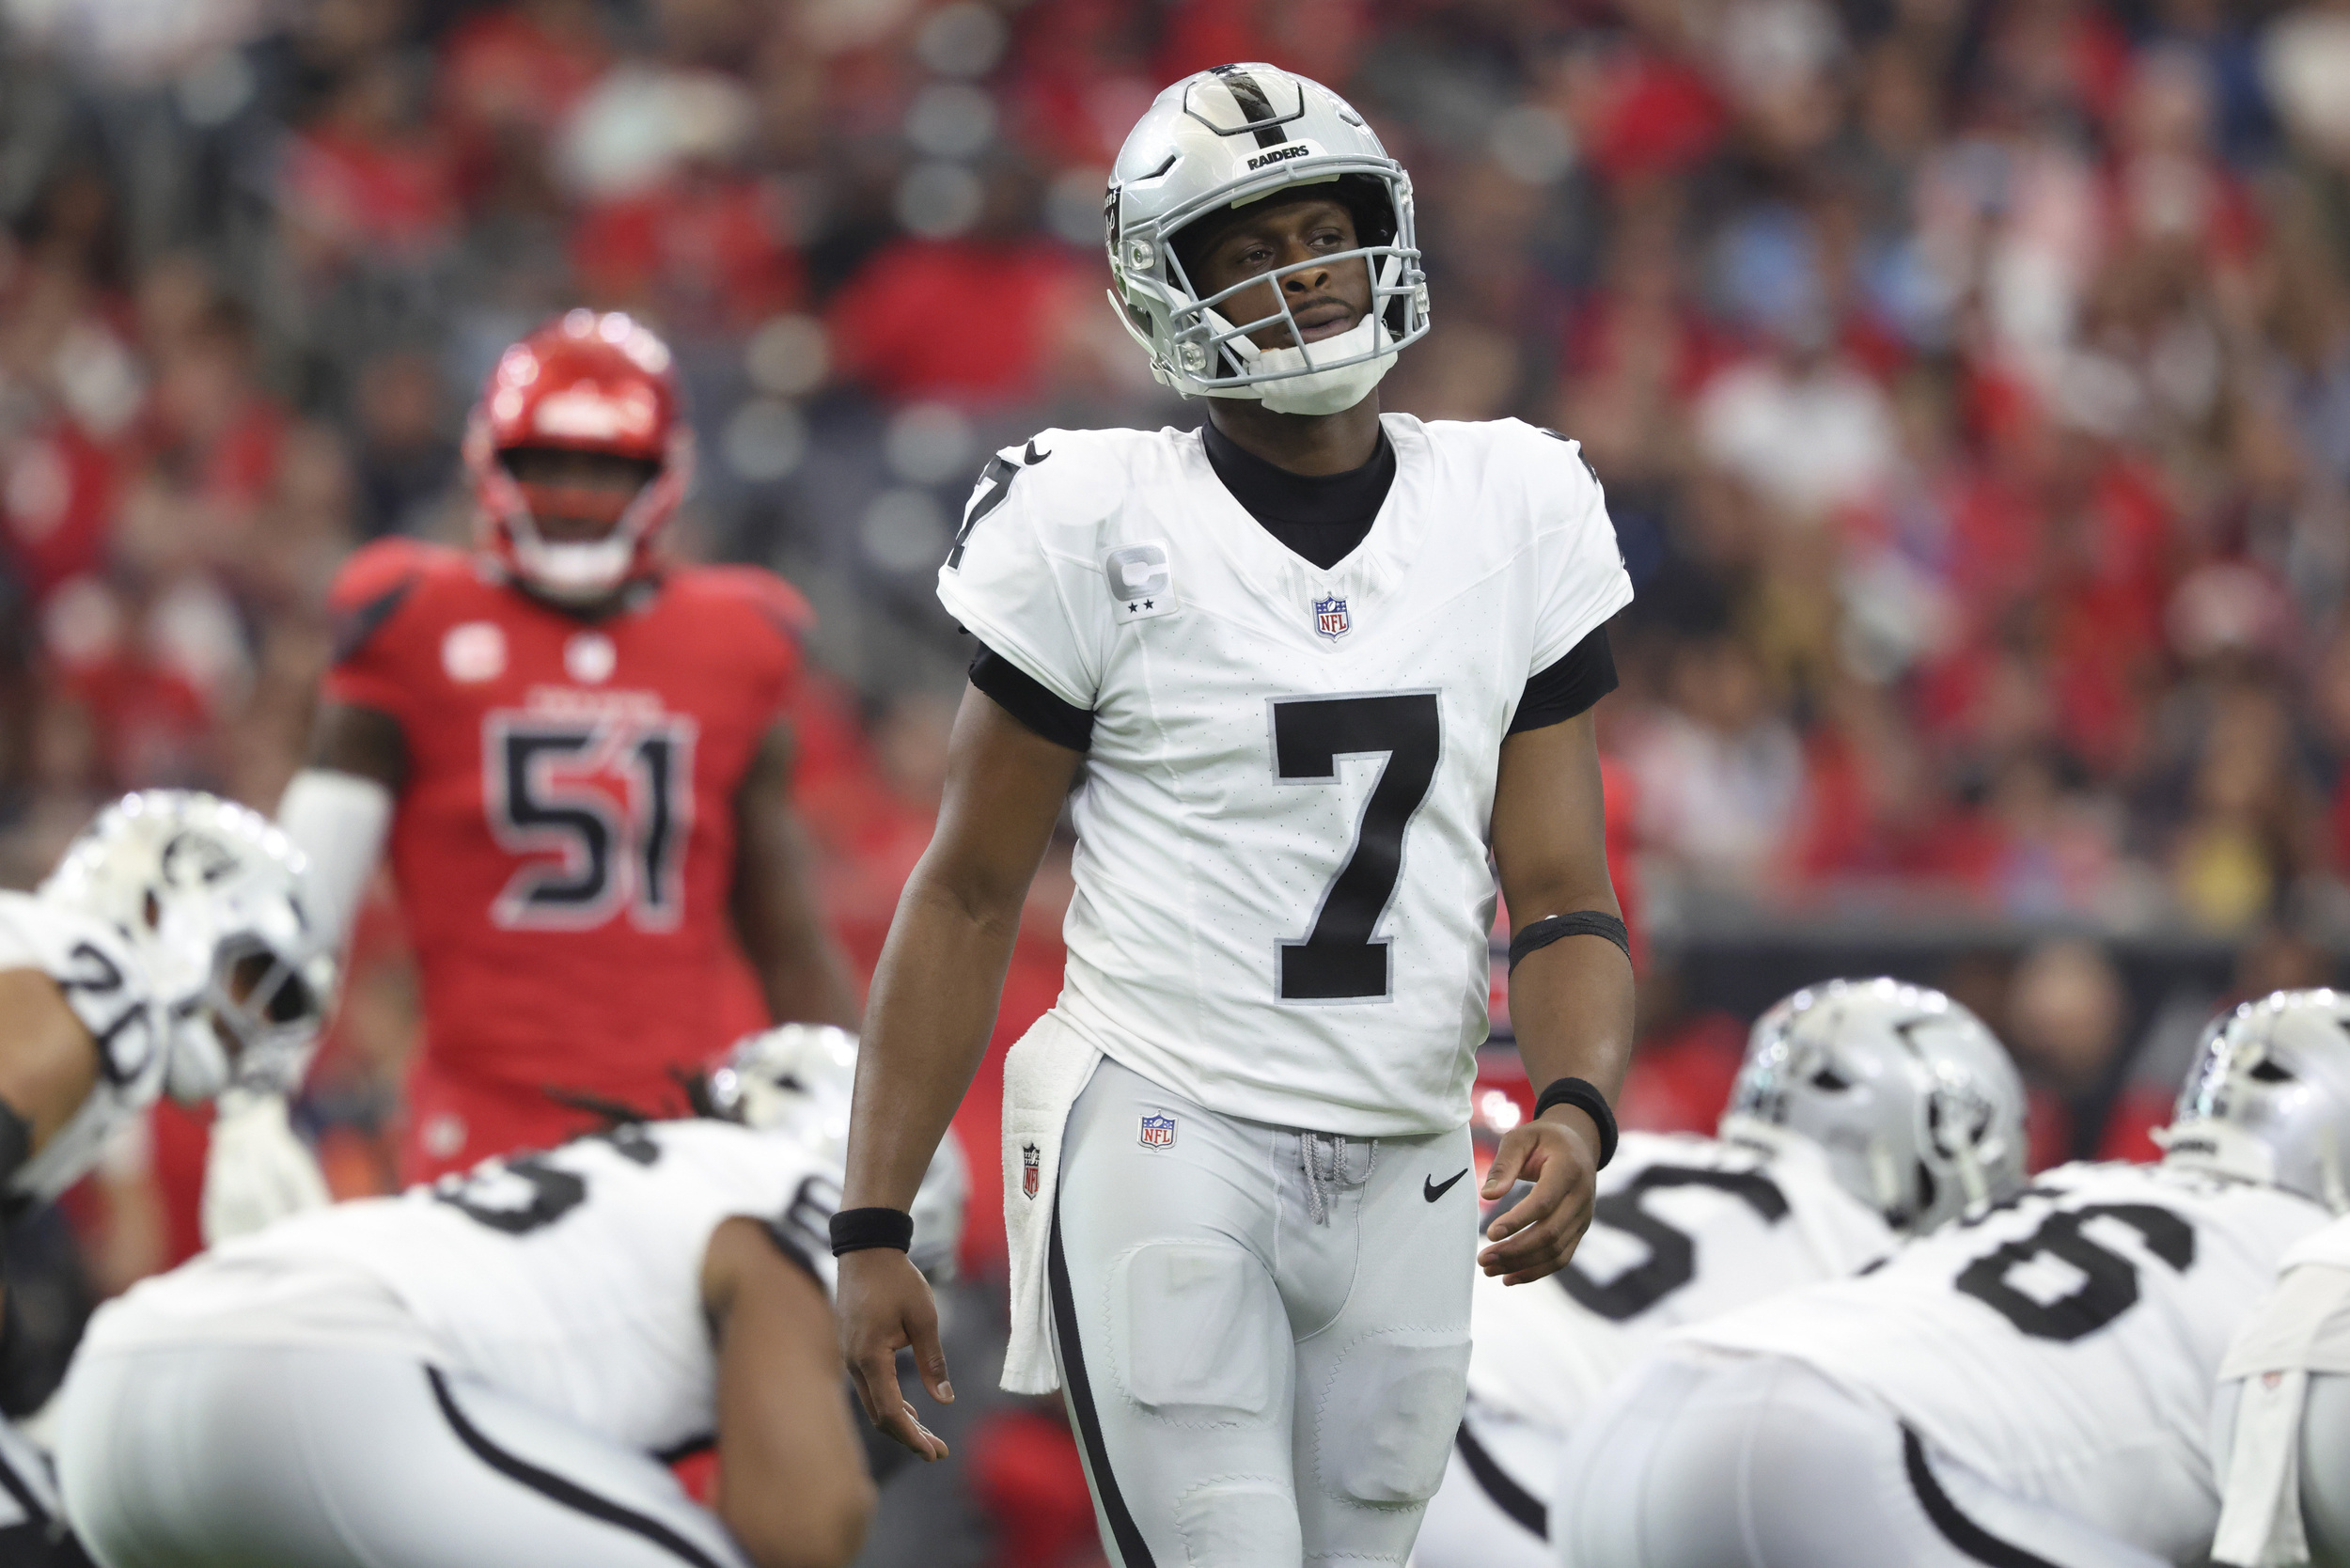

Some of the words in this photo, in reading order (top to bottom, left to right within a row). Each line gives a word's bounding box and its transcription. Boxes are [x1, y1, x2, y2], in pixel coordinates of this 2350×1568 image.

[1247, 145, 1309, 170] RAIDERS
[948, 454, 1023, 575] 7
[1107, 544, 1170, 602] C
[1320, 614, 1347, 633] NFL
[482, 708, 698, 933] 51
[1266, 687, 1446, 1005] 7
[1144, 1128, 1170, 1144] NFL
[1954, 1188, 2196, 1343] 6
